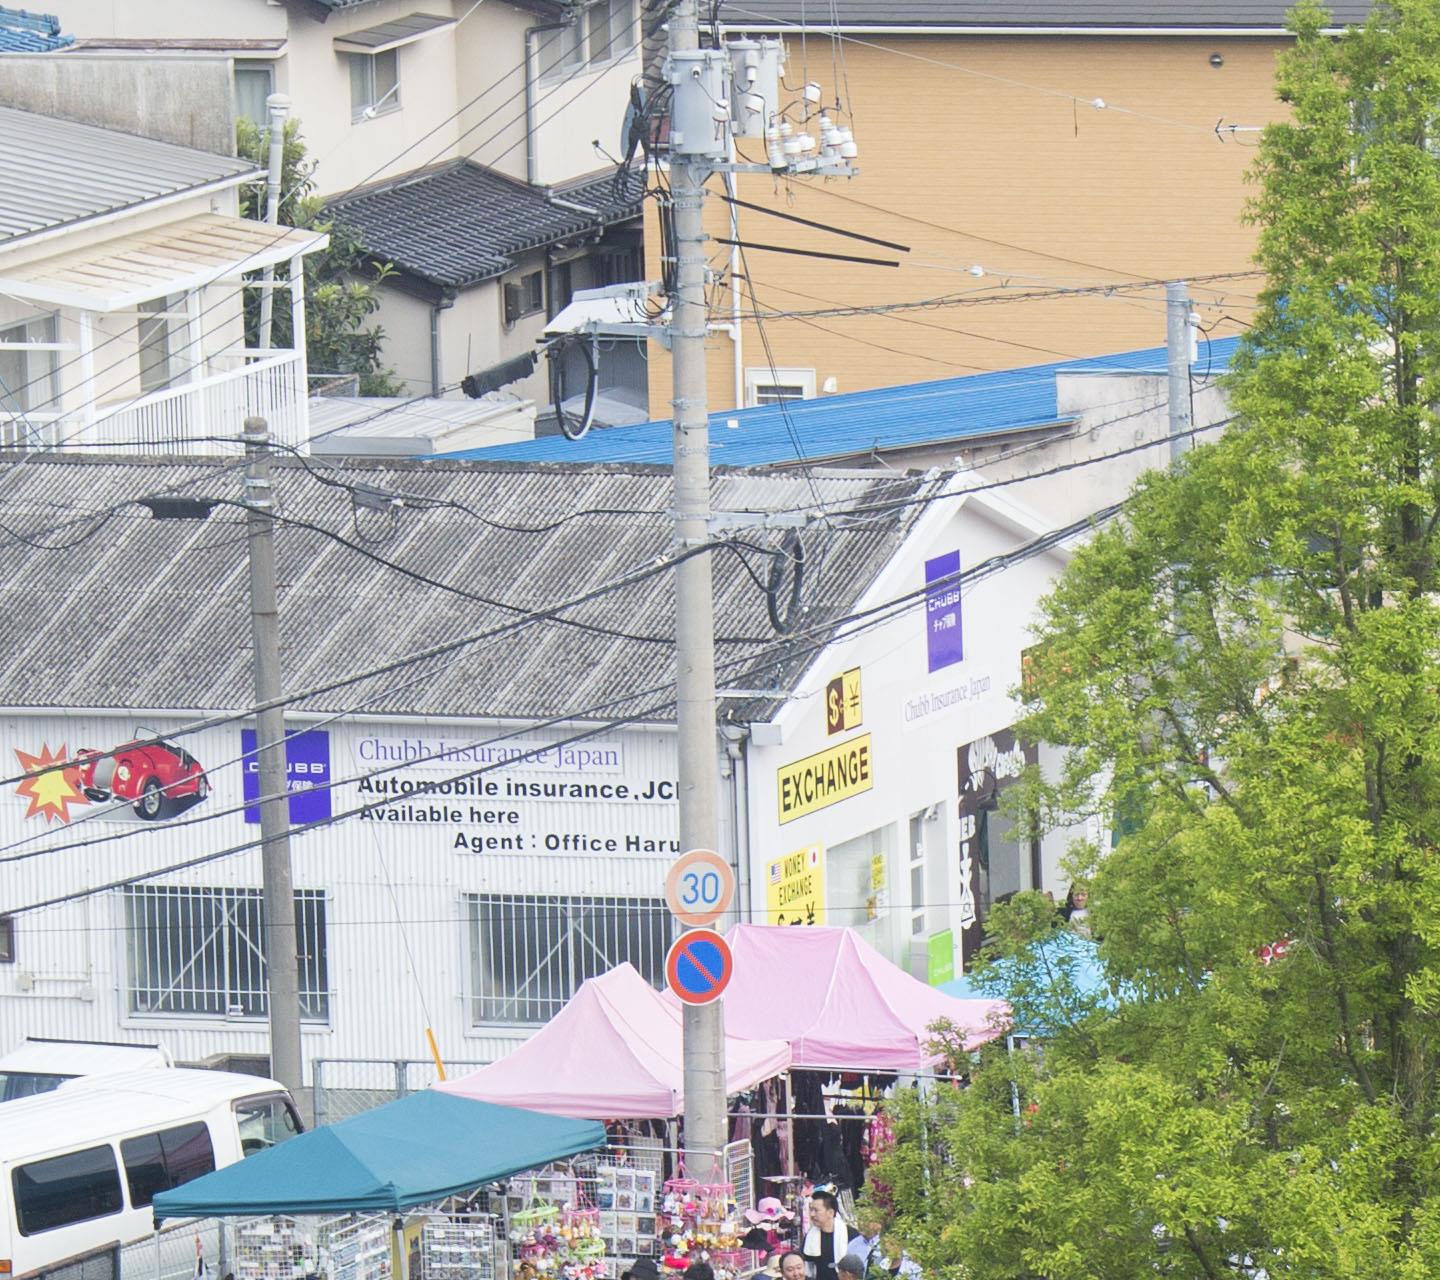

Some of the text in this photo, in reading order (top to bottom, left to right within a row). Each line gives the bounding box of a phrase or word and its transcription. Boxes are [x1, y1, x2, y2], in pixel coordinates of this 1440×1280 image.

[928, 590, 960, 612] CHUBB
[360, 739, 619, 770] Chubb Insurance Japan
[358, 775, 498, 797] Automobile
[782, 745, 869, 813] EXCHANGE
[360, 805, 520, 824] Available here
[454, 832, 524, 854] Agent
[544, 834, 618, 852] Office
[784, 852, 806, 878] MONEY
[682, 872, 719, 904] 30
[778, 874, 813, 906] EXCHANGE
